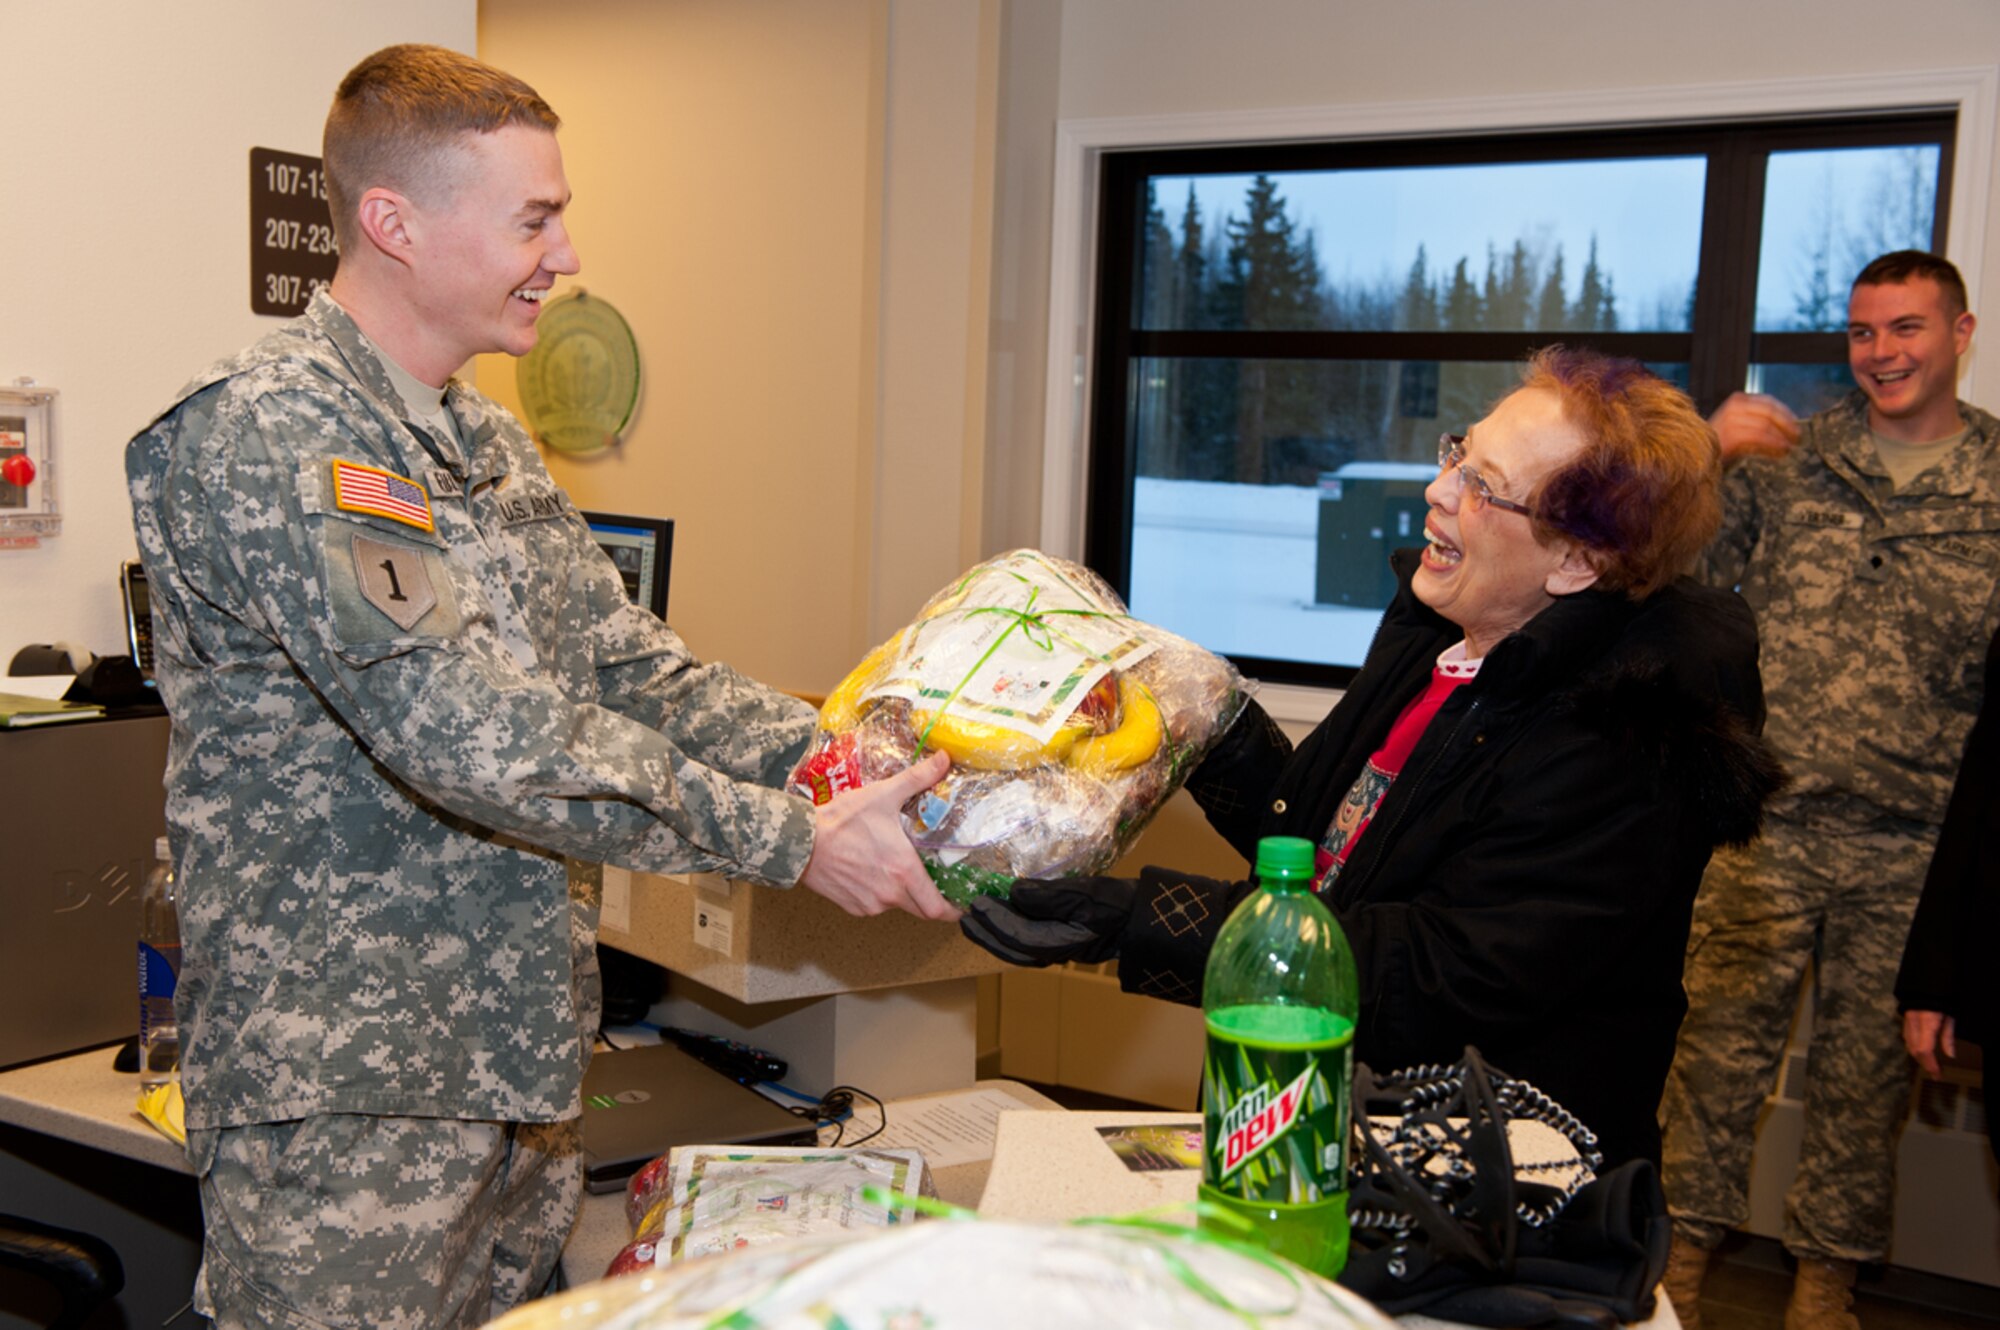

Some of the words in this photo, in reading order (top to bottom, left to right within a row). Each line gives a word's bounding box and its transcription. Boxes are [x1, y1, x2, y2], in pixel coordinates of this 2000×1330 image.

[265, 162, 329, 201] 107-13
[499, 500, 530, 522] U.S.
[530, 493, 564, 516] ARMY
[379, 559, 407, 602] 1
